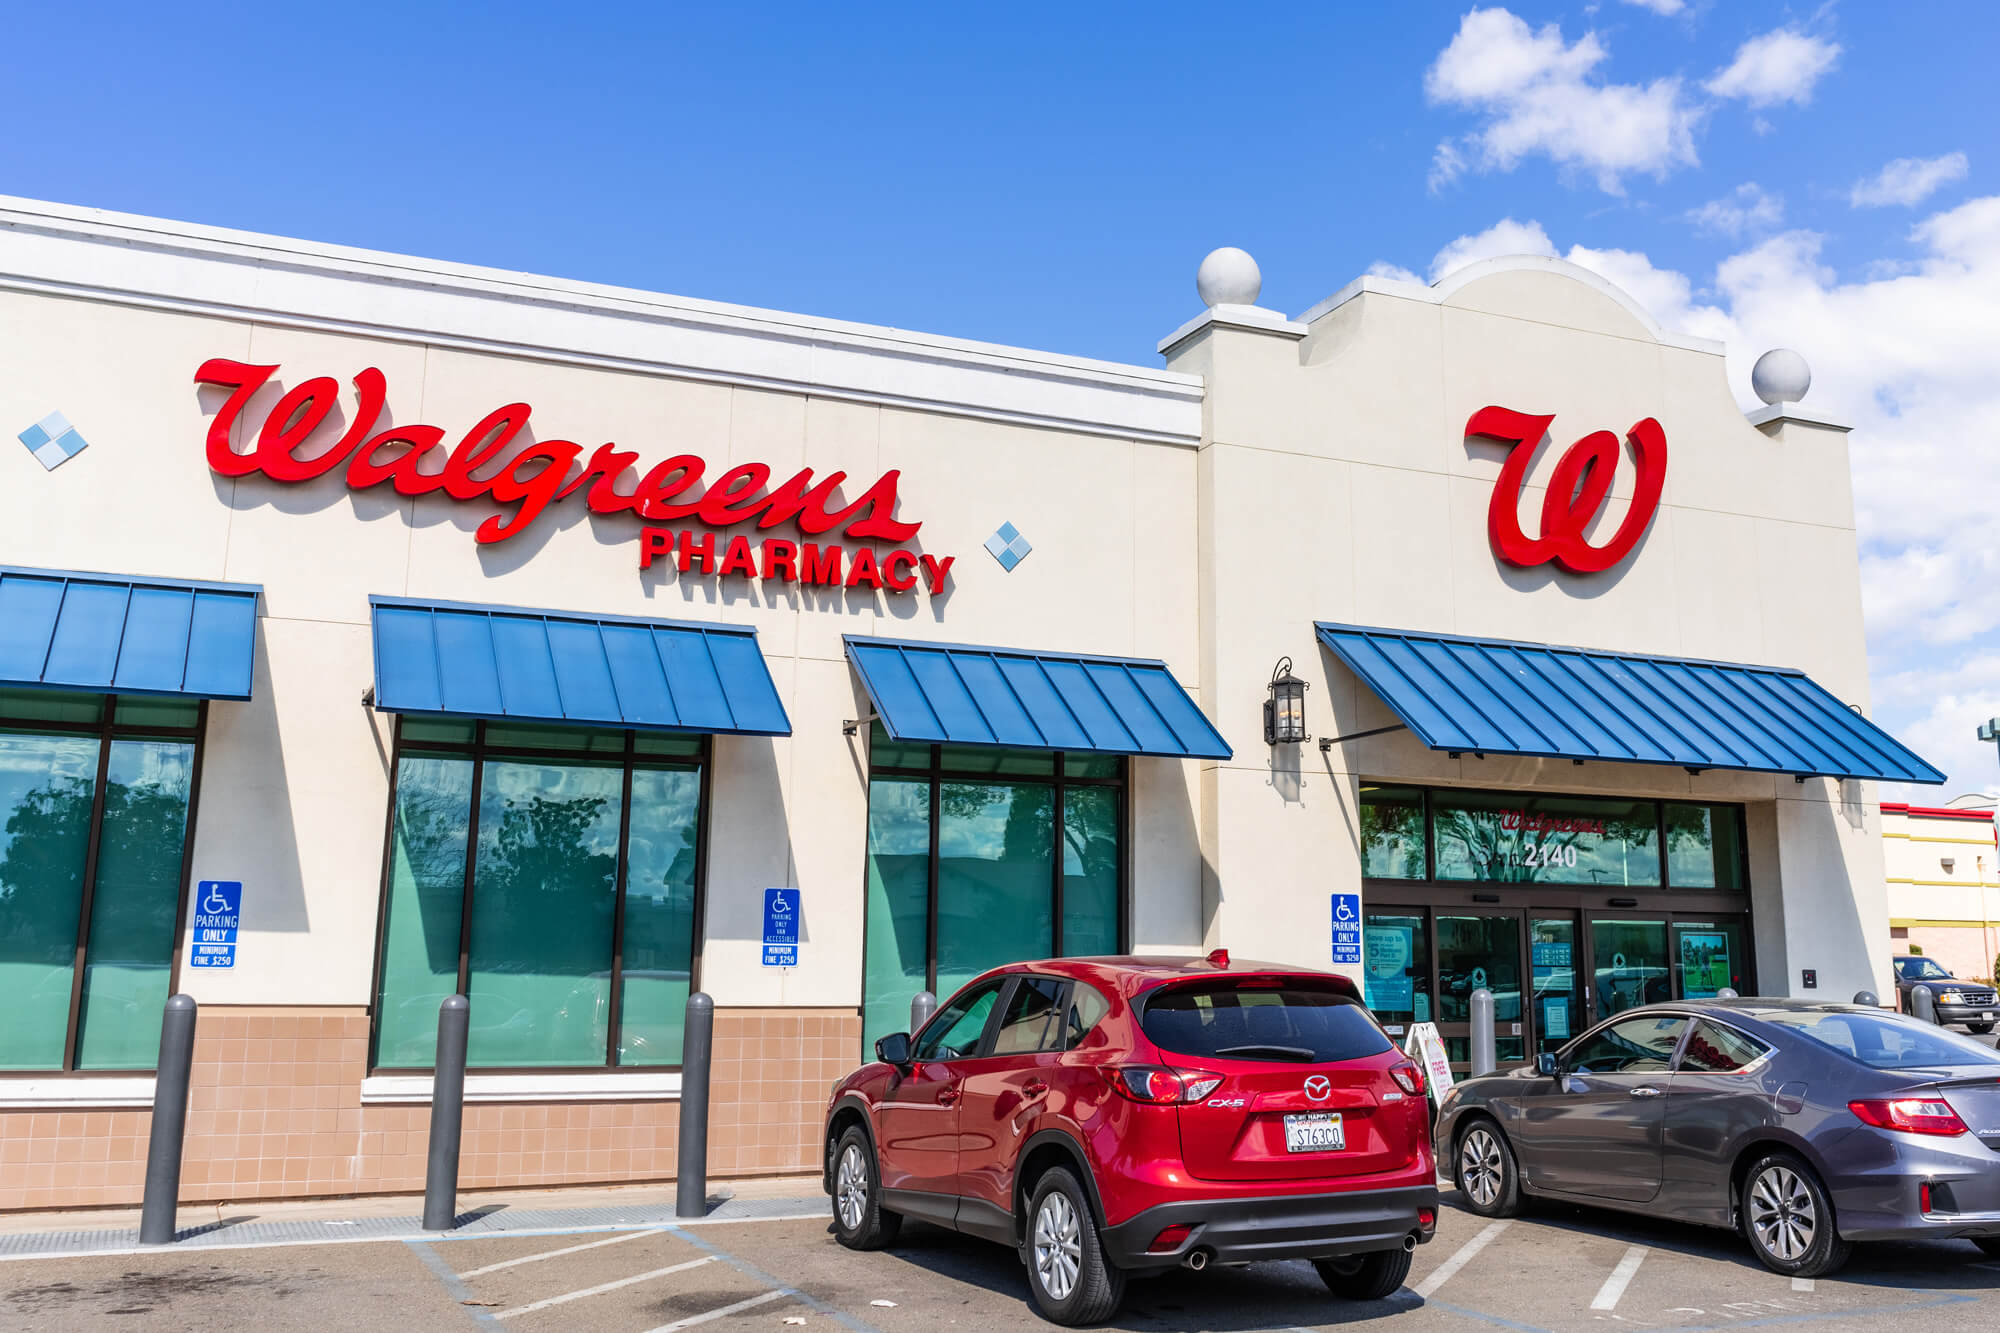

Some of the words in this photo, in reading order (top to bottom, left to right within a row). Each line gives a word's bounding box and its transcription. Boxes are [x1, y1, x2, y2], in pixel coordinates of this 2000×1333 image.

[194, 358, 922, 545] Walgreens
[1464, 405, 1668, 574] W
[639, 525, 956, 596] PHARMACY
[1500, 808, 1606, 840] Walgreens
[1524, 842, 1577, 868] 2140
[196, 915, 237, 928] PARKING
[1333, 921, 1359, 931] PARKING
[203, 929, 228, 941] ONLY
[766, 935, 795, 943] ACCESSIBLE
[1338, 932, 1354, 943] ONLY
[199, 946, 228, 954] MINIMUM
[194, 956, 209, 965] FINE
[212, 956, 231, 965] $250
[764, 956, 777, 964] FINE
[779, 956, 795, 965] $250
[1208, 1099, 1245, 1108] CX-5
